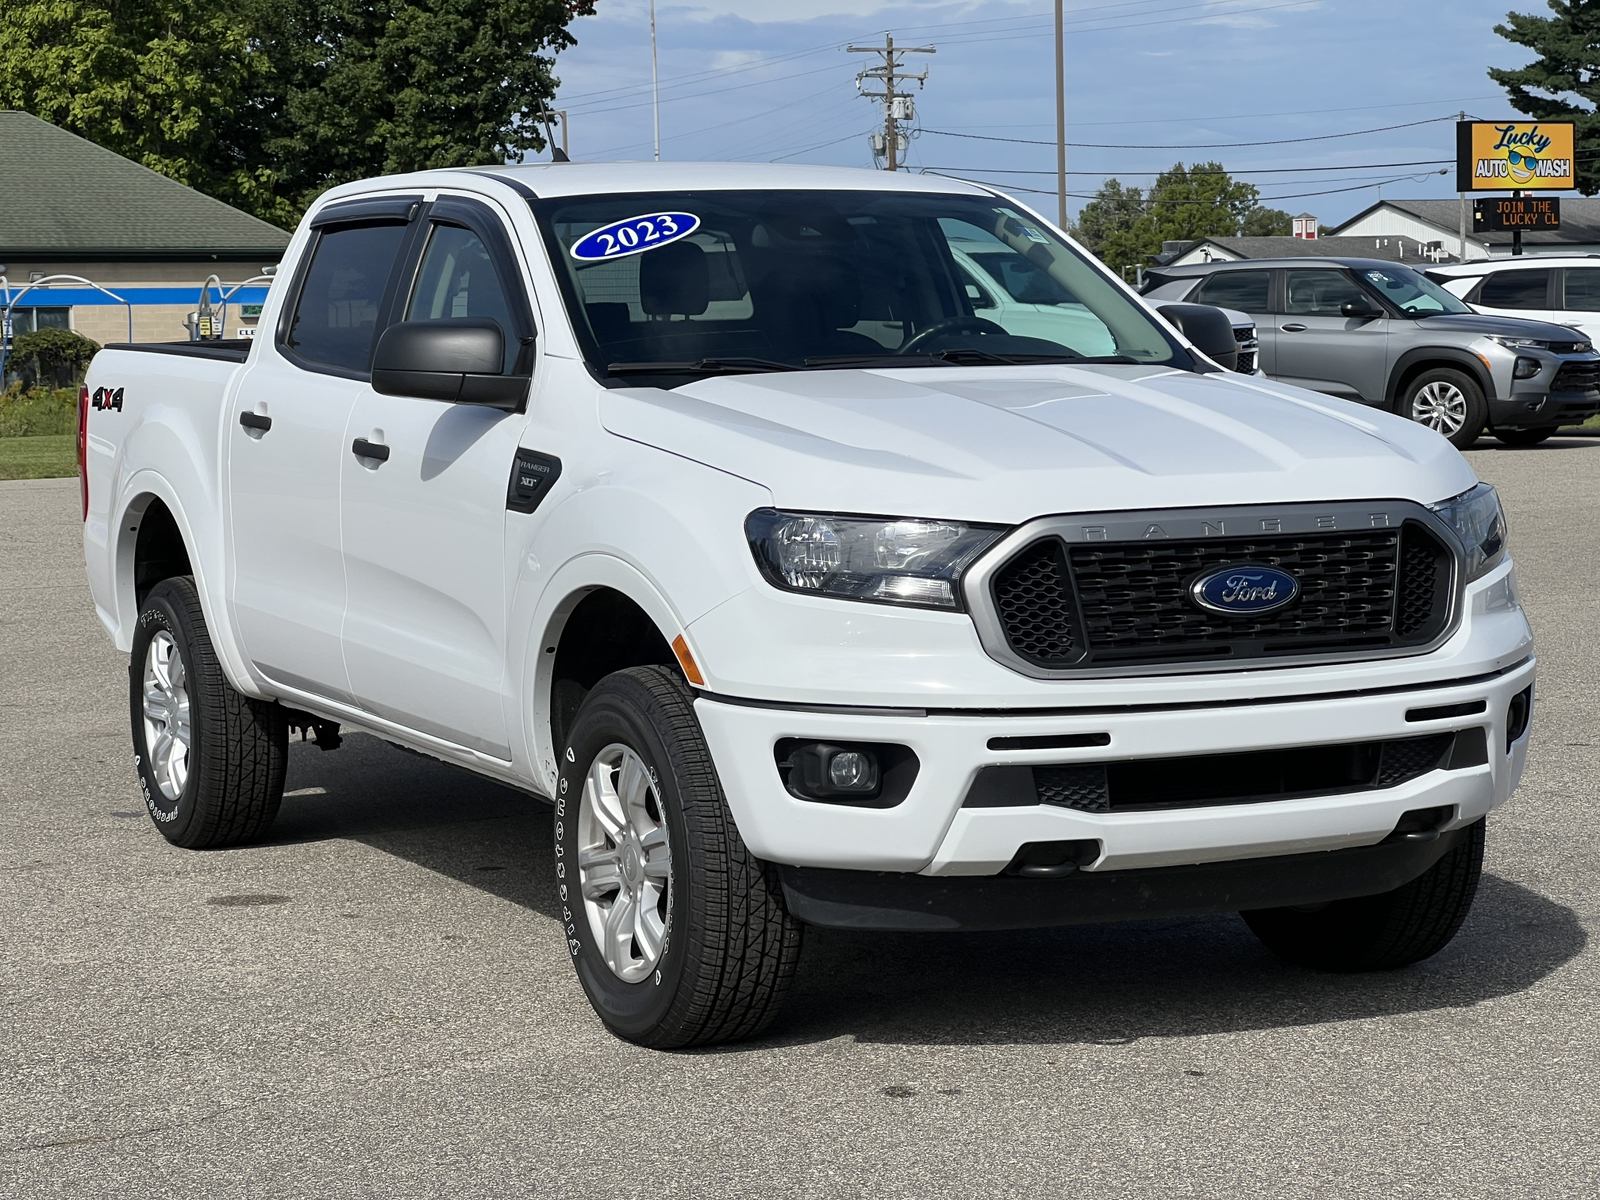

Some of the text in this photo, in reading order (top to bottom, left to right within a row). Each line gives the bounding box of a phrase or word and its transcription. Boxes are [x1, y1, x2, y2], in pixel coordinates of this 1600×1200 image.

[1493, 125, 1551, 153] Lucky
[1475, 158, 1570, 178] AUTO WASH
[1496, 201, 1551, 213] JOIN THE
[1502, 213, 1559, 225] LUCKY CL
[596, 215, 679, 256] 2023
[520, 461, 550, 474] RANGER
[520, 476, 537, 487] XLT
[1081, 512, 1390, 540] RANGER
[1222, 574, 1278, 602] Ford
